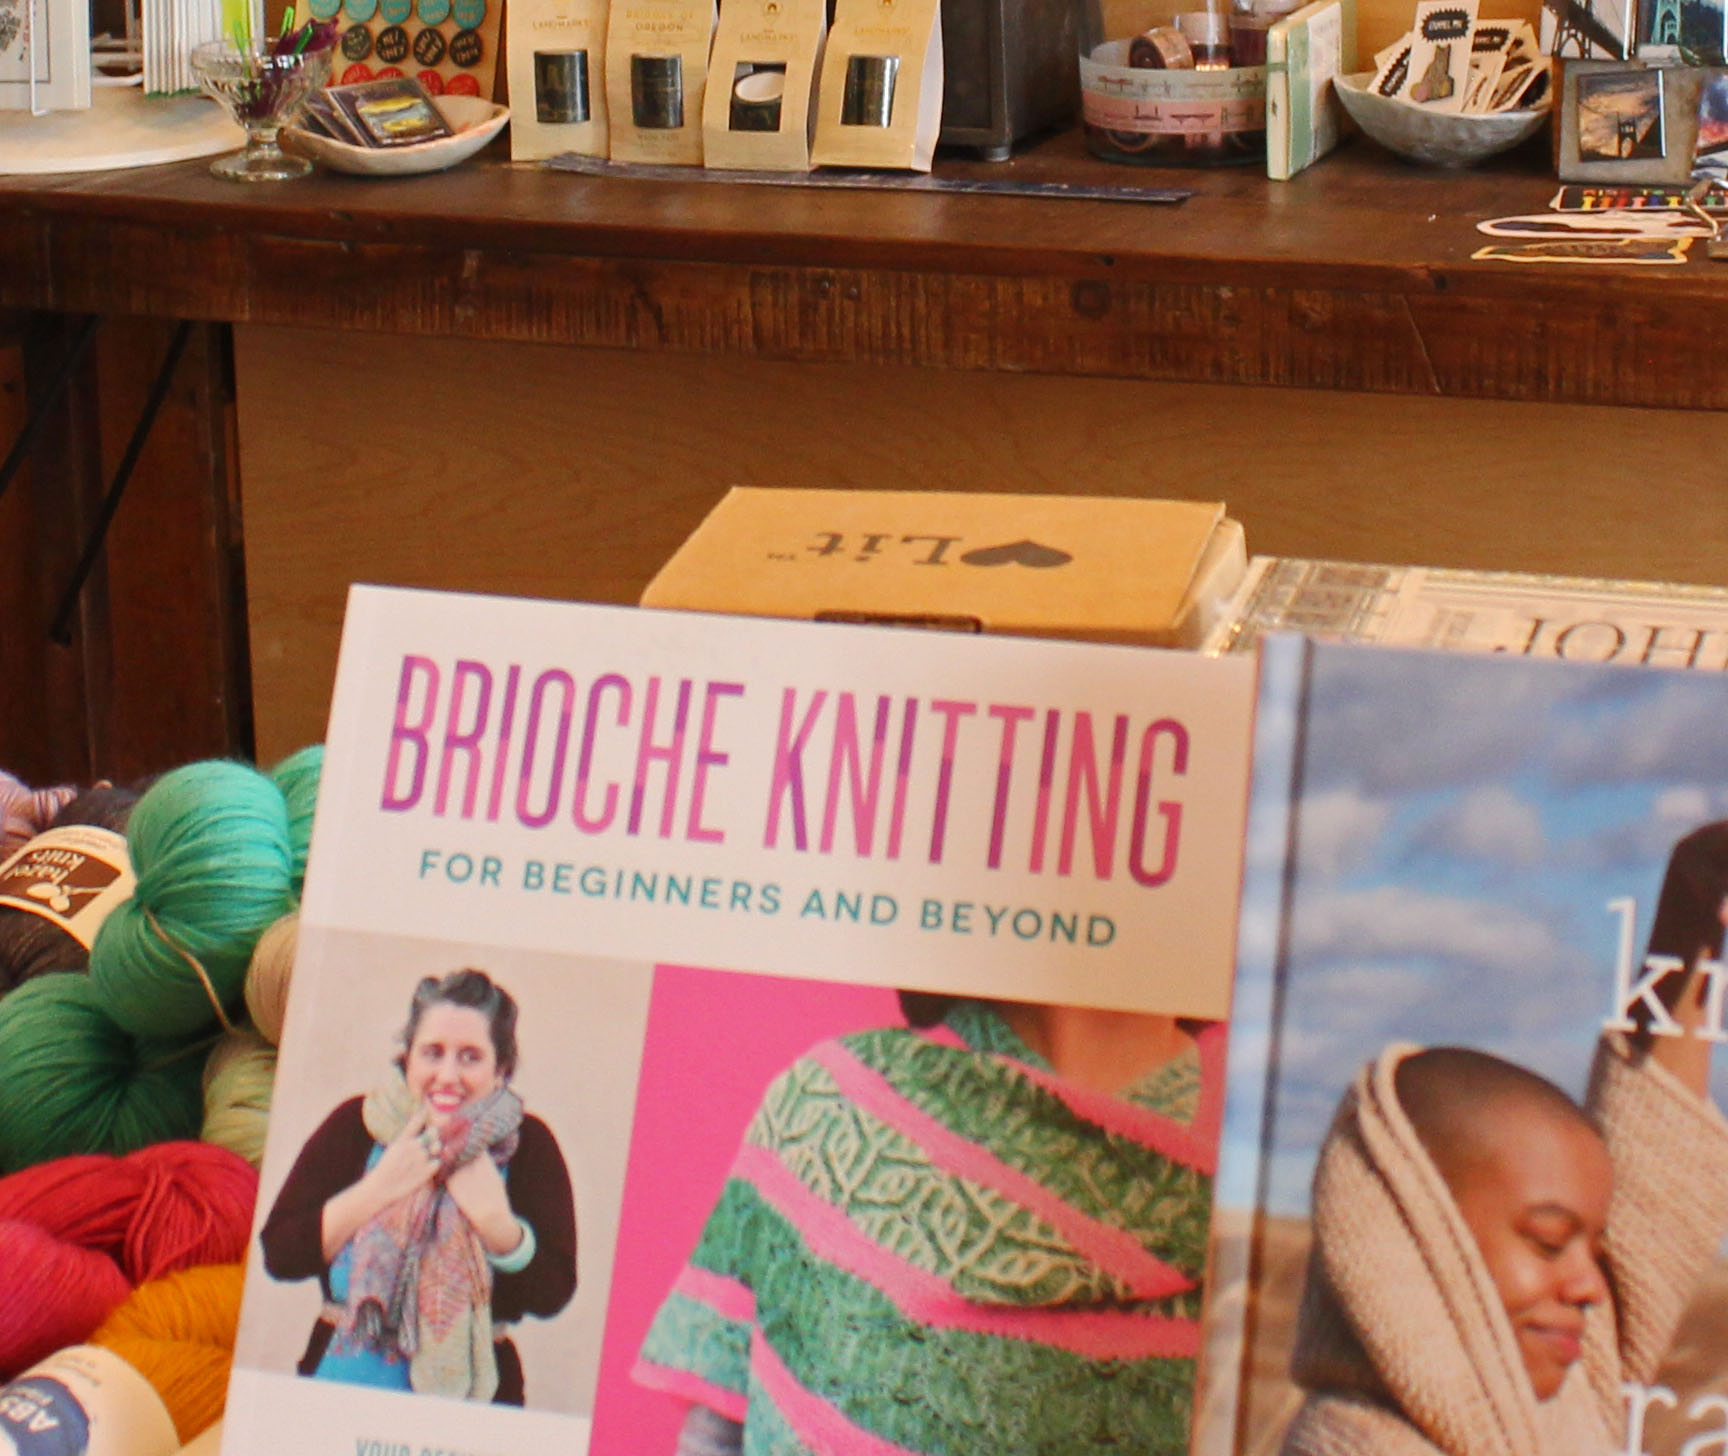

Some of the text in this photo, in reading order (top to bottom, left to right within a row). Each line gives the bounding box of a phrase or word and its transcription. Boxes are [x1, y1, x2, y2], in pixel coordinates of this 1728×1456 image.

[805, 529, 965, 567] Lit
[379, 653, 1191, 888] BRIOCHE KNITTING
[418, 848, 1118, 948] FOR BEGINNERS AND BEYOND
